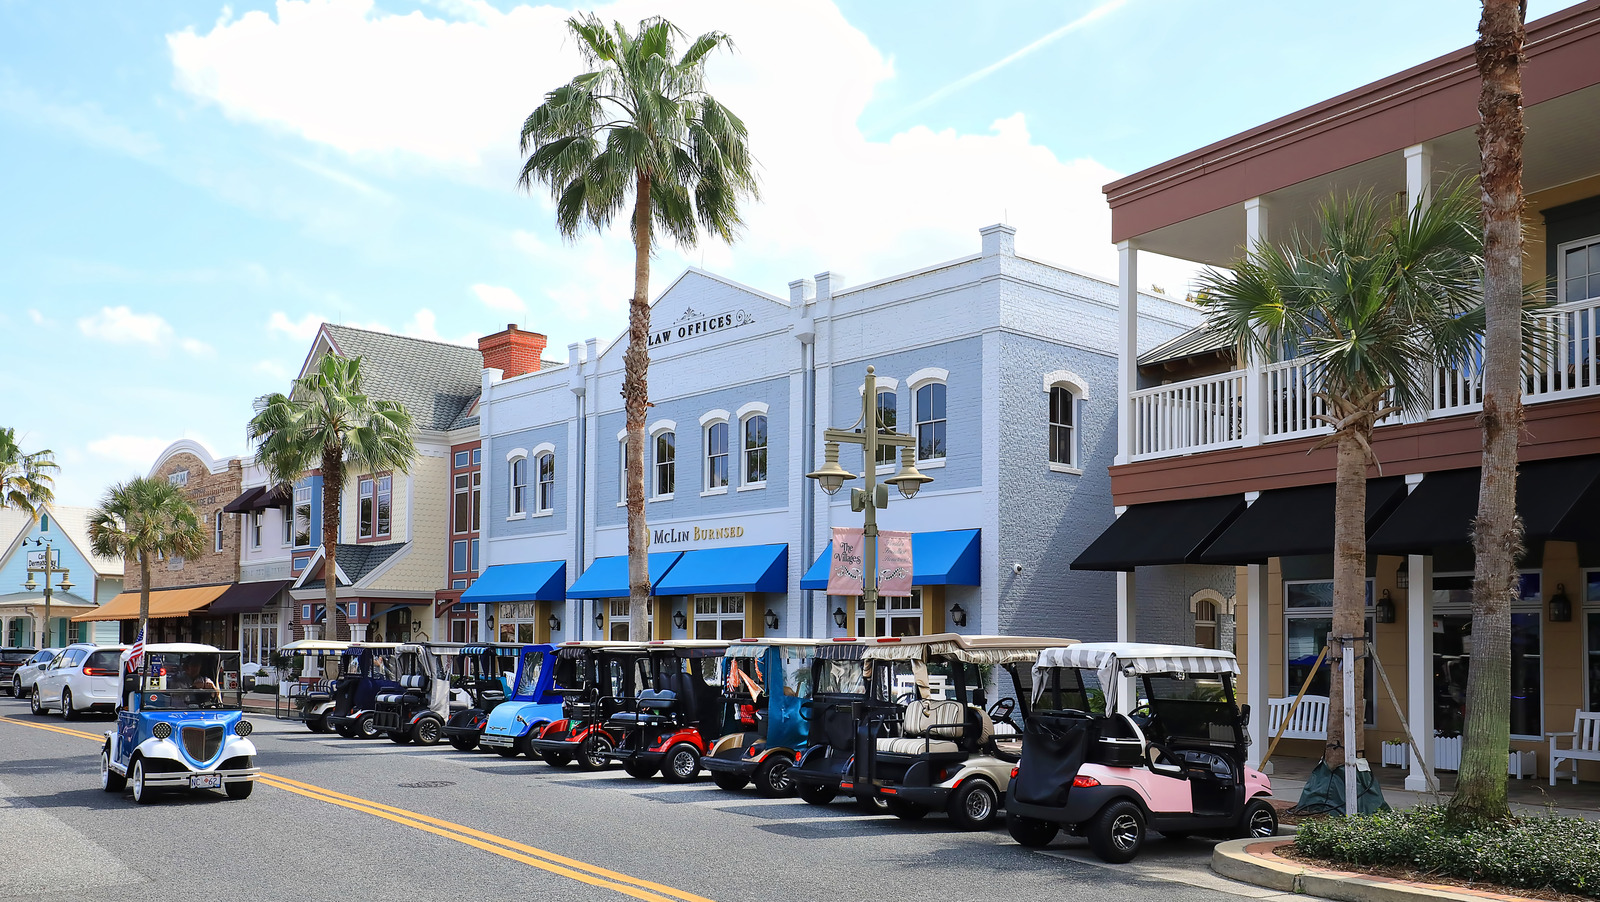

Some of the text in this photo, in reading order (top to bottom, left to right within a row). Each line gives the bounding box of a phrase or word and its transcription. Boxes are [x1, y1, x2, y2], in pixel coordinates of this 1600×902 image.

[648, 314, 732, 346] LAW OFFICES
[693, 526, 744, 541] BURNSED
[840, 541, 853, 553] The
[834, 552, 861, 565] Villages
